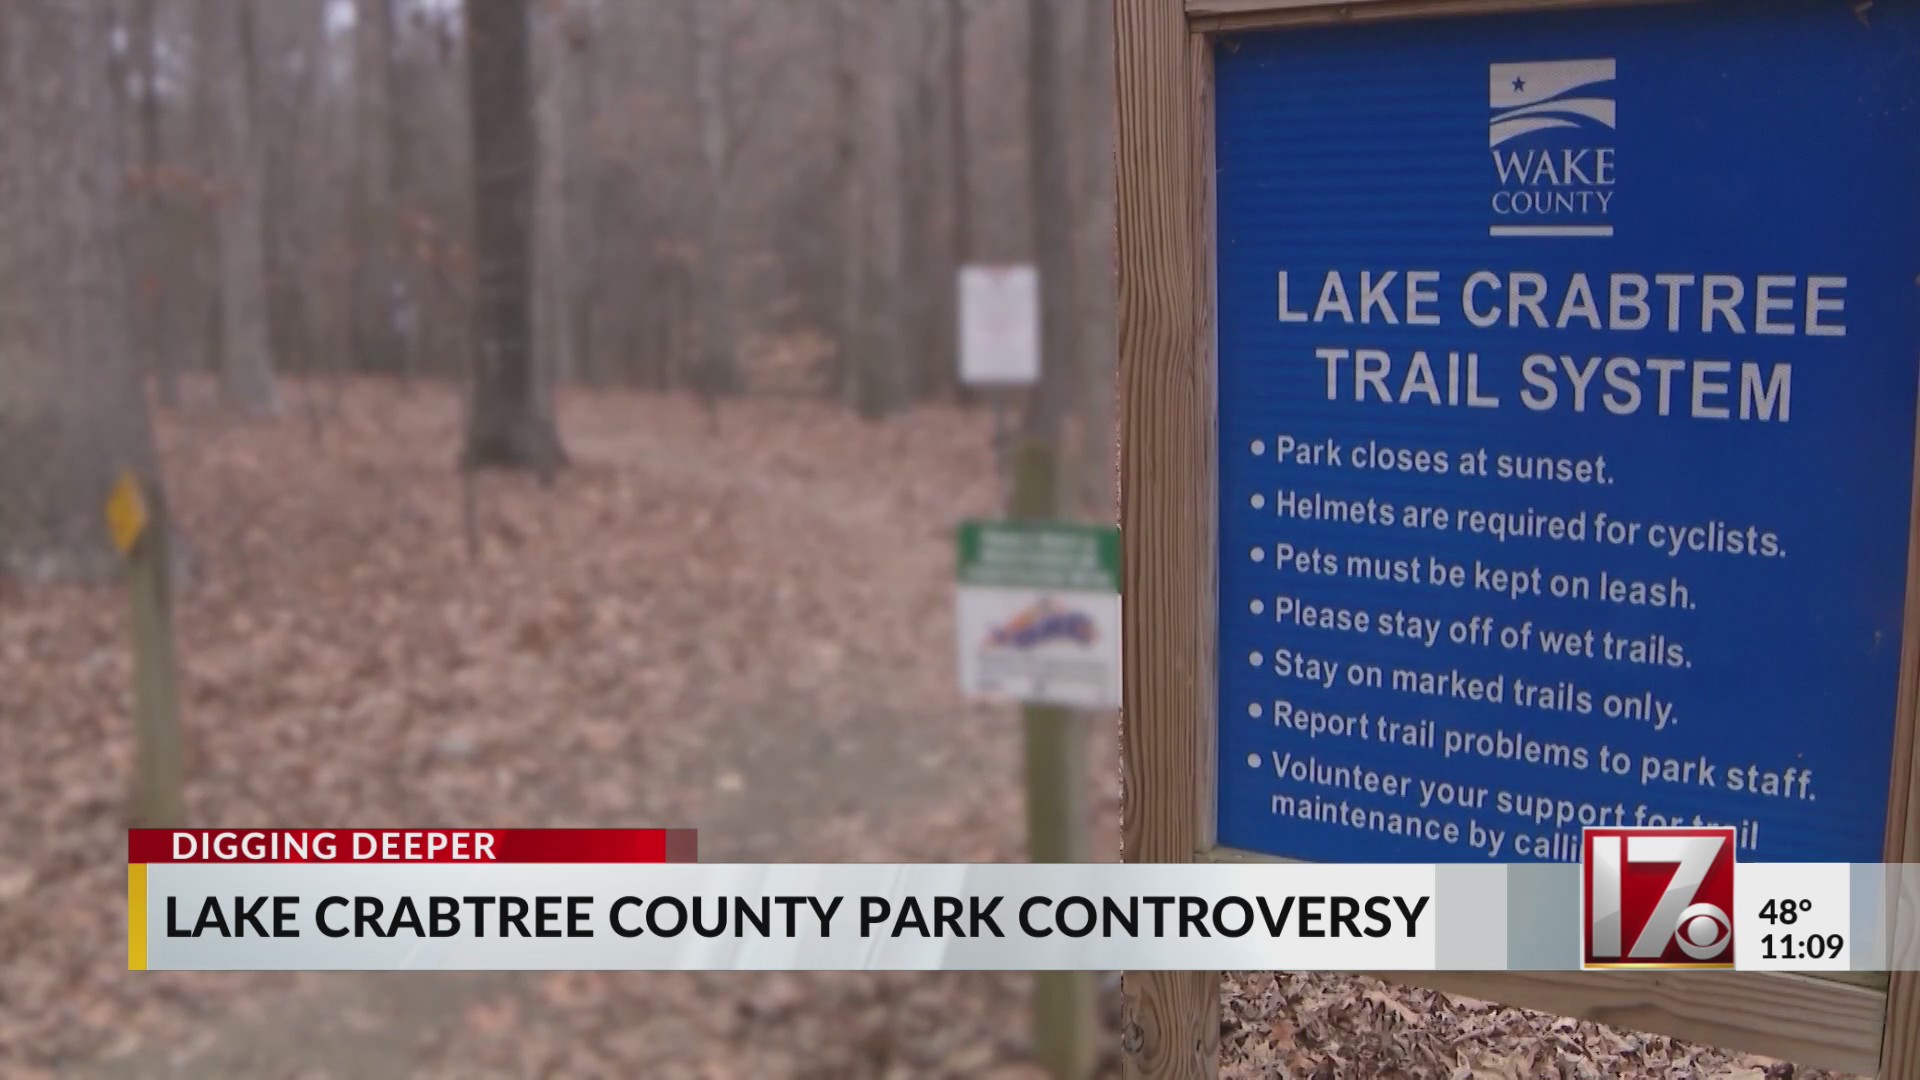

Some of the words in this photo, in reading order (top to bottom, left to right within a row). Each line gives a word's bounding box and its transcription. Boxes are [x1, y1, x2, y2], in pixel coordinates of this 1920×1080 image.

[1491, 148, 1615, 186] WAKE
[1491, 191, 1613, 214] COUNTY
[1278, 271, 1441, 325] LAKE
[1462, 271, 1847, 336] CRABTREE
[1315, 348, 1499, 409] TRAIL
[1520, 354, 1792, 422] SYSTEM
[1277, 435, 1341, 466] Park
[1351, 441, 1449, 474] closes
[1459, 449, 1487, 476] at
[1497, 455, 1614, 484] sunset.
[1277, 490, 1395, 526] Helmets
[1402, 506, 1449, 530] are
[1457, 510, 1586, 542] required
[1594, 513, 1641, 544] for
[1648, 521, 1786, 557] cyclists.
[1277, 543, 1338, 575] Pets
[1347, 557, 1421, 583] must
[1429, 557, 1465, 587] be
[1475, 561, 1541, 600] kept
[1550, 575, 1589, 599] on
[1600, 572, 1697, 609] leash.
[1276, 596, 1370, 632] Please
[1378, 611, 1441, 647] stay
[1449, 616, 1494, 646] off
[1500, 621, 1533, 650] of
[1539, 630, 1594, 658] wet
[1603, 631, 1692, 668] trails.
[1275, 648, 1338, 688] Stay
[1347, 664, 1382, 688] on
[1392, 664, 1504, 702] marked
[1514, 679, 1592, 714] trails
[1603, 692, 1678, 730] only.
[1274, 700, 1369, 739] Report
[1377, 716, 1435, 748] trail
[1445, 731, 1589, 769] problems
[1599, 745, 1631, 775] to
[1641, 757, 1715, 786] park
[1727, 765, 1815, 800] staff.
[1272, 751, 1412, 796] Volunteer
[1419, 780, 1489, 808] your
[1497, 792, 1625, 828] support
[1272, 795, 1459, 843] maintenance
[1469, 819, 1505, 857] by
[1514, 829, 1583, 863] calli
